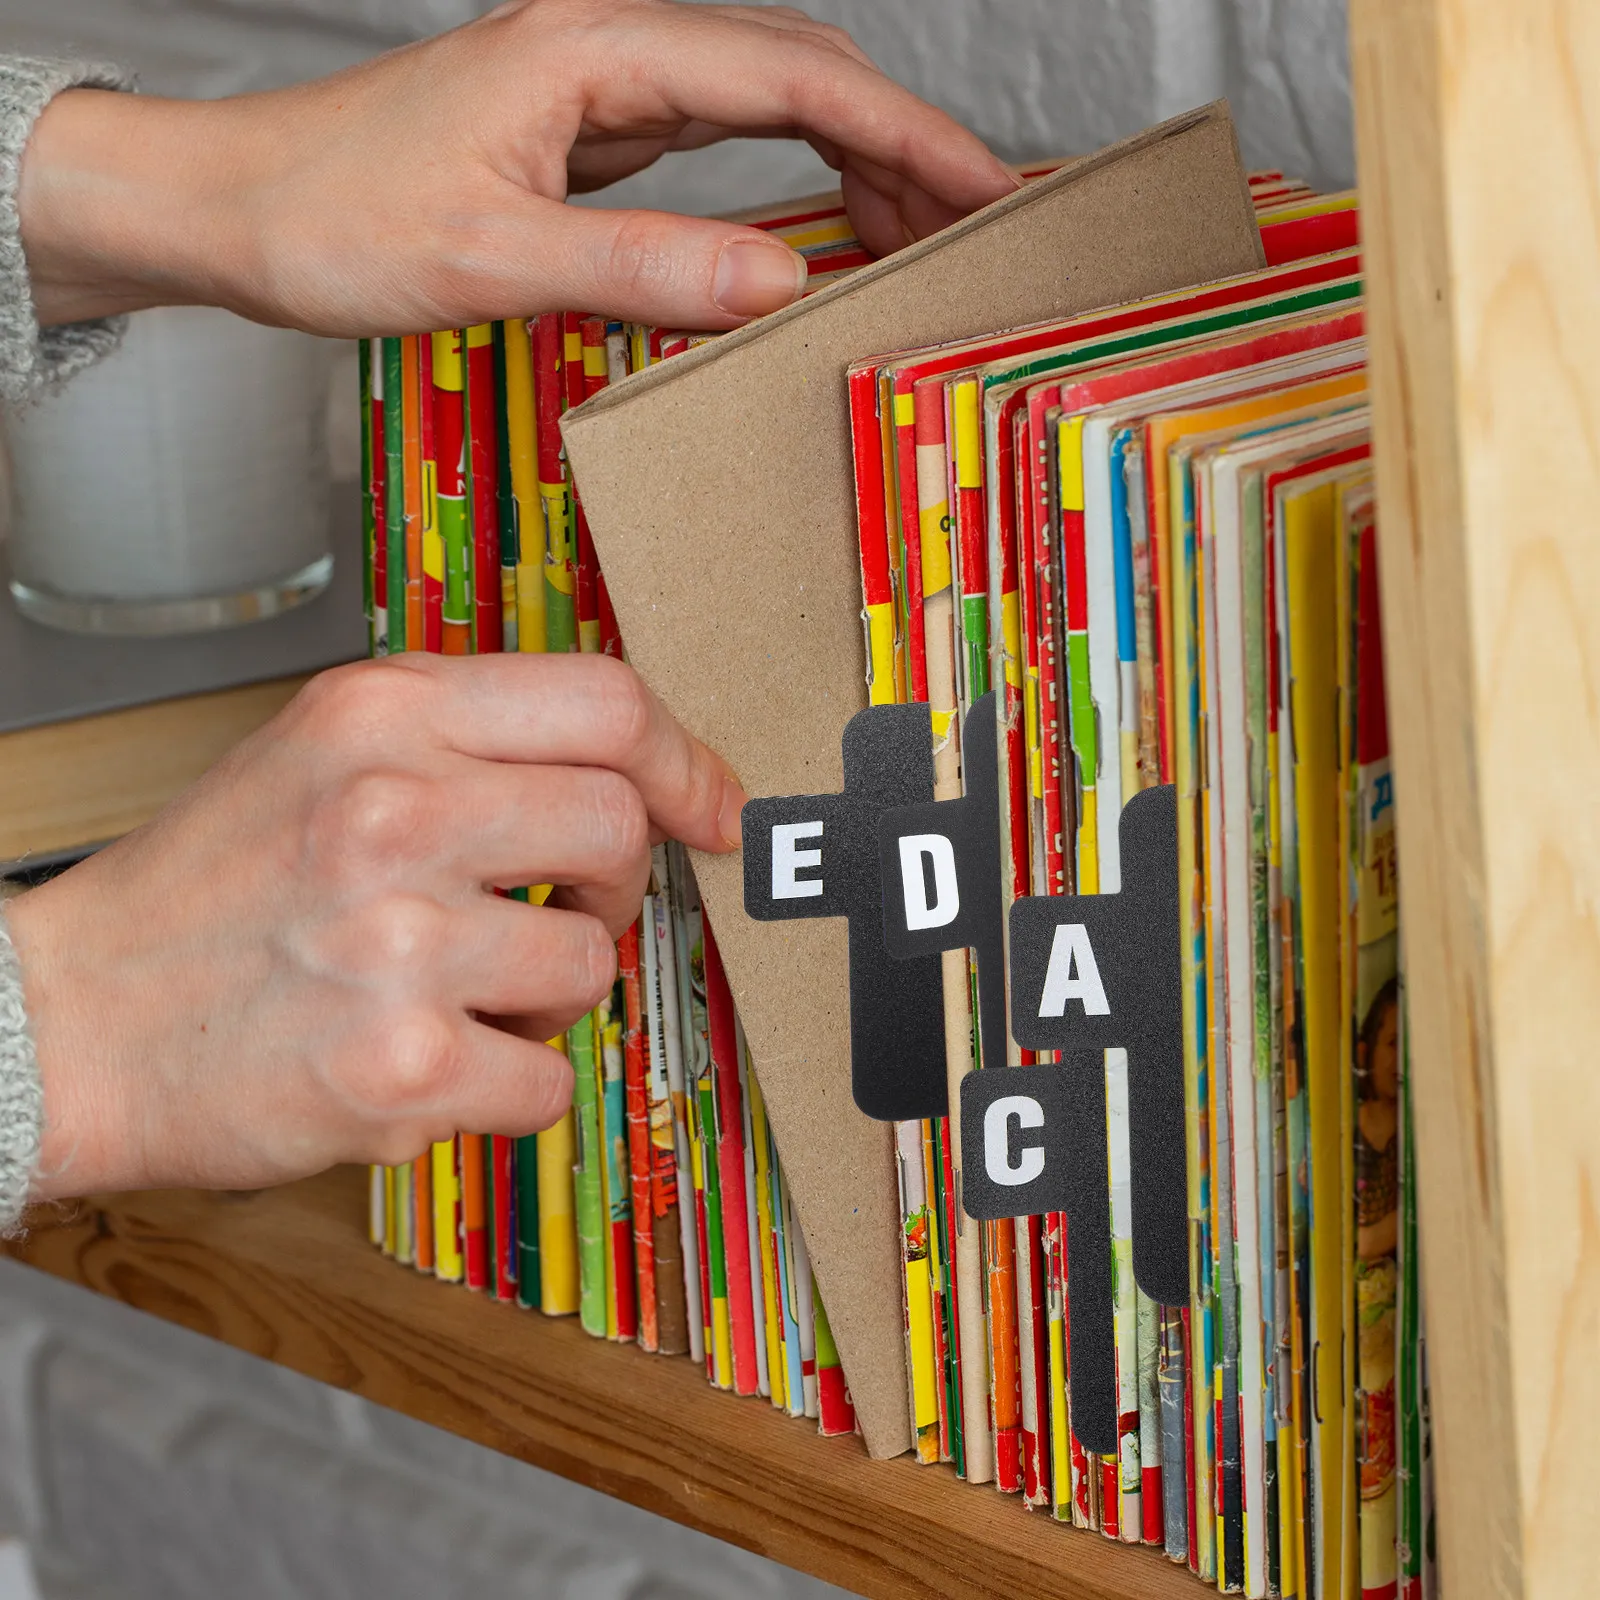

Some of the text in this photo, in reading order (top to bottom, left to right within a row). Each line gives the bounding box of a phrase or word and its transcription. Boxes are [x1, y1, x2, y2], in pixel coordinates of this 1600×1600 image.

[772, 821, 823, 899] E
[898, 834, 960, 931] D
[1038, 924, 1110, 1018] A
[984, 1095, 1046, 1186] C
